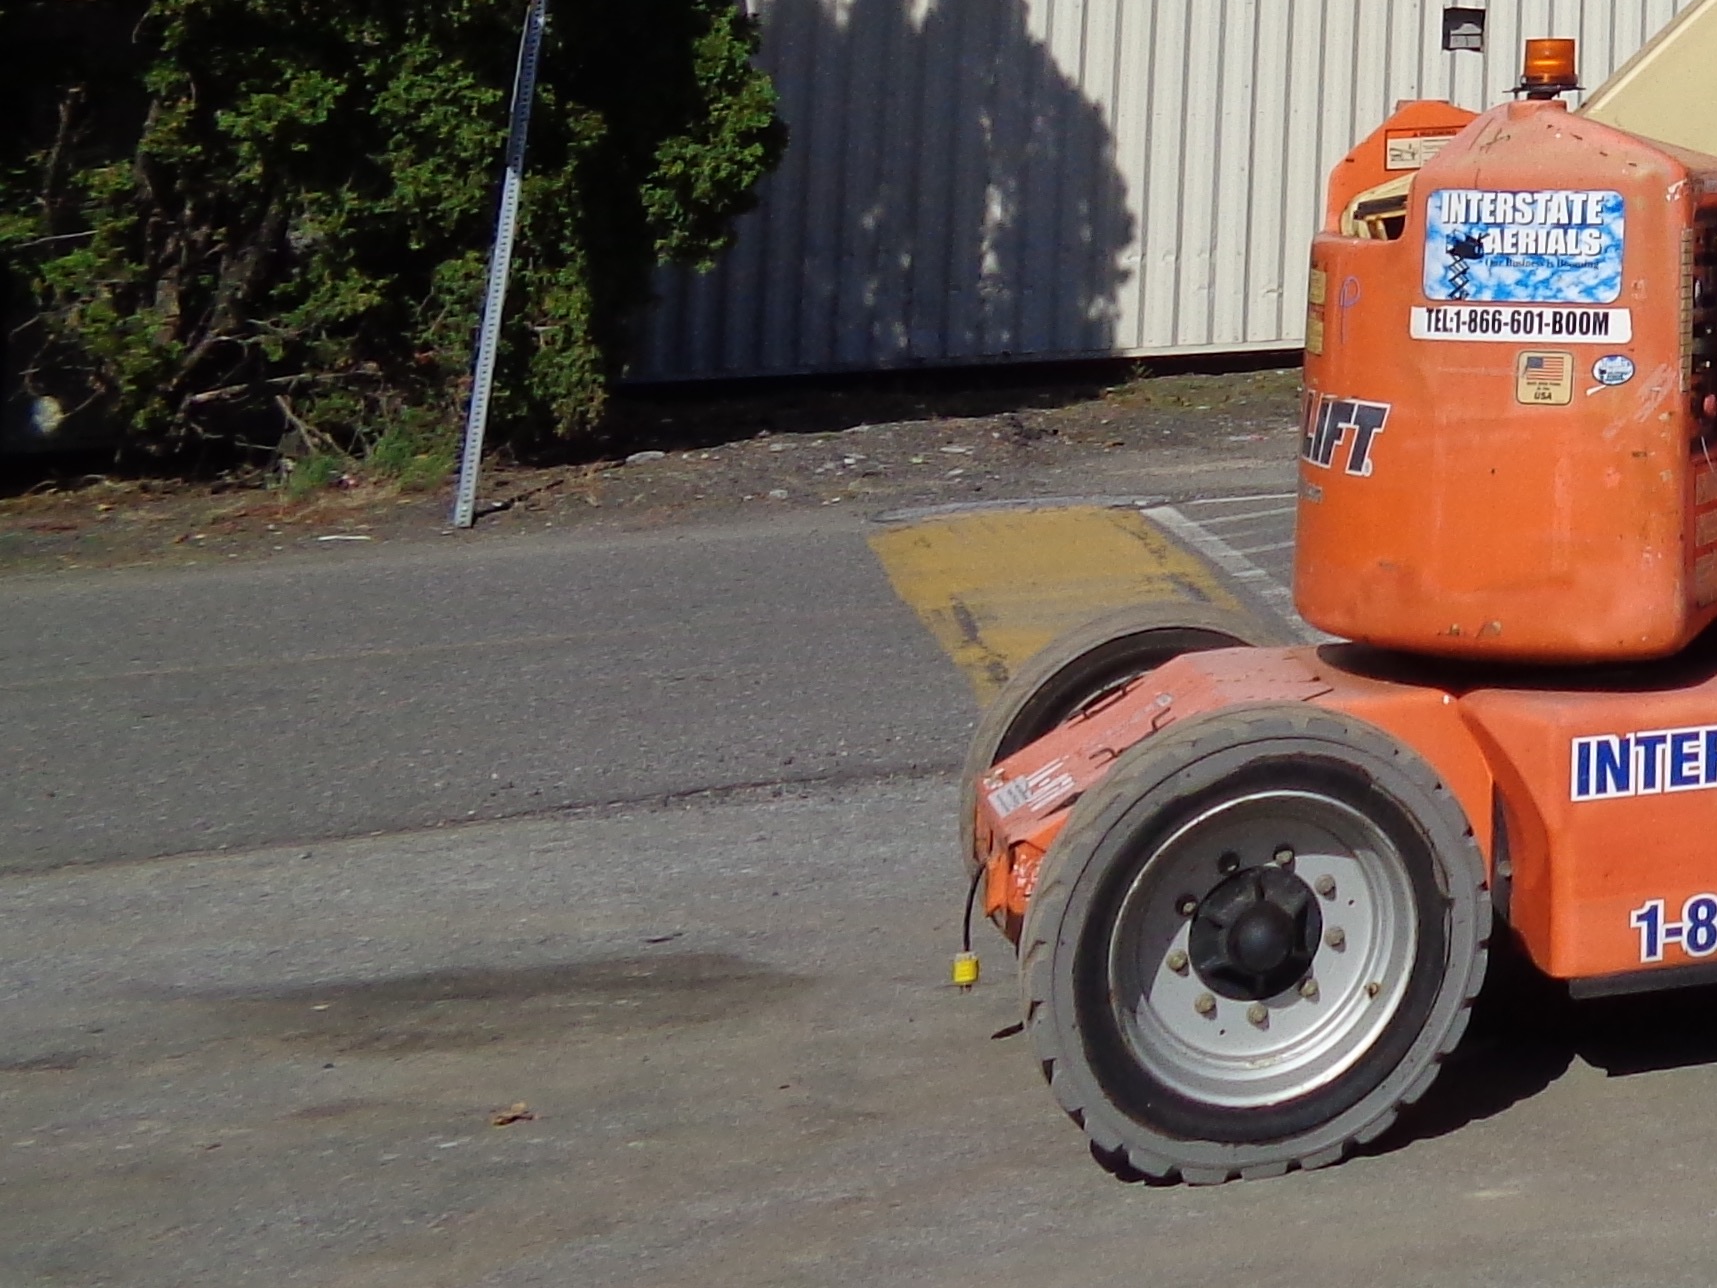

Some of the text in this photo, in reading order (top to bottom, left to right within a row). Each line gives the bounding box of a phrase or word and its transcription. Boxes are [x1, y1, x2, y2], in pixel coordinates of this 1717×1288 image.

[1441, 192, 1605, 226] INTERSTATE
[1483, 227, 1603, 256] AERIALS
[1425, 307, 1610, 337] TEL:1-866-601-BOOM
[1533, 391, 1553, 401] USA
